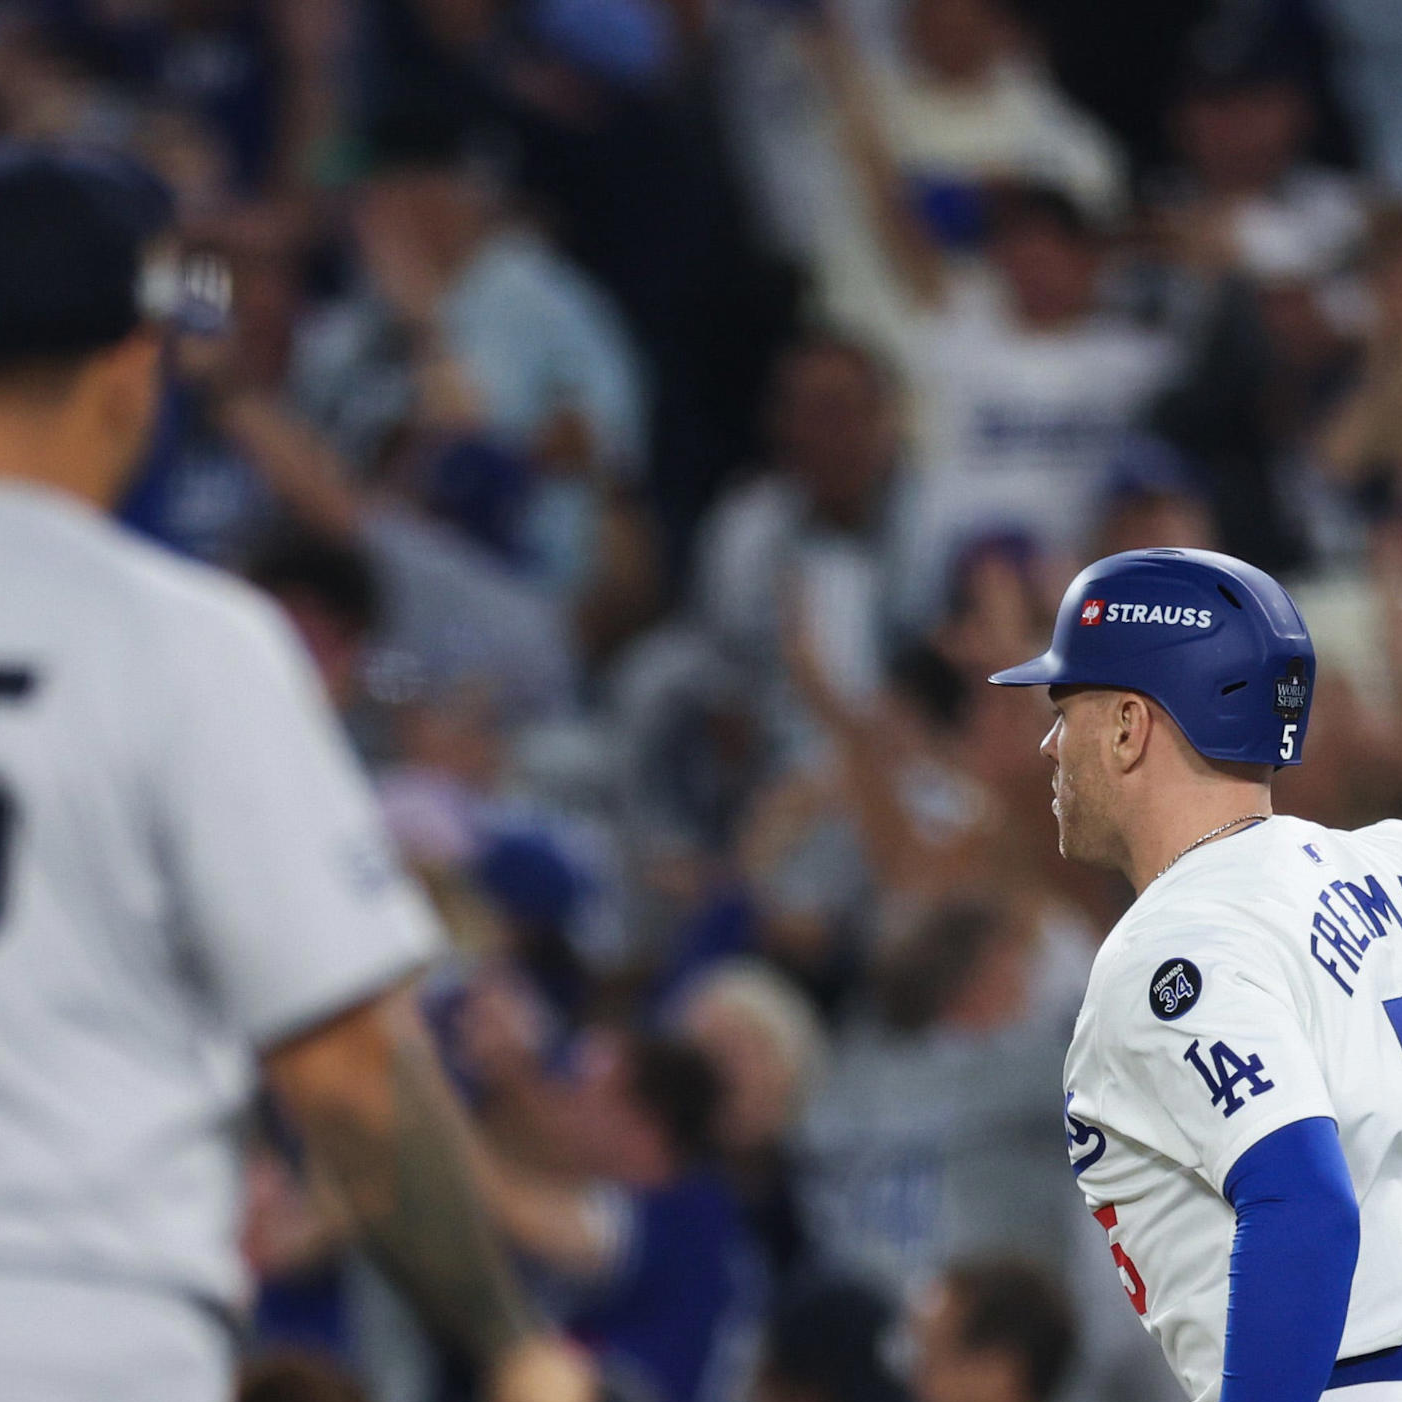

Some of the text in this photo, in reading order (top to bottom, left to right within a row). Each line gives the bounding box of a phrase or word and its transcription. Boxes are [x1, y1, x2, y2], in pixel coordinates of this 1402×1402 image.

[1105, 603, 1213, 629] STRAUSS
[1277, 683, 1306, 697] WORLD
[1277, 695, 1304, 708] SERIES
[1279, 724, 1297, 760] 5
[1152, 963, 1184, 995] FERNANDO
[1159, 973, 1195, 1013] 34
[1183, 1038, 1275, 1119] LA
